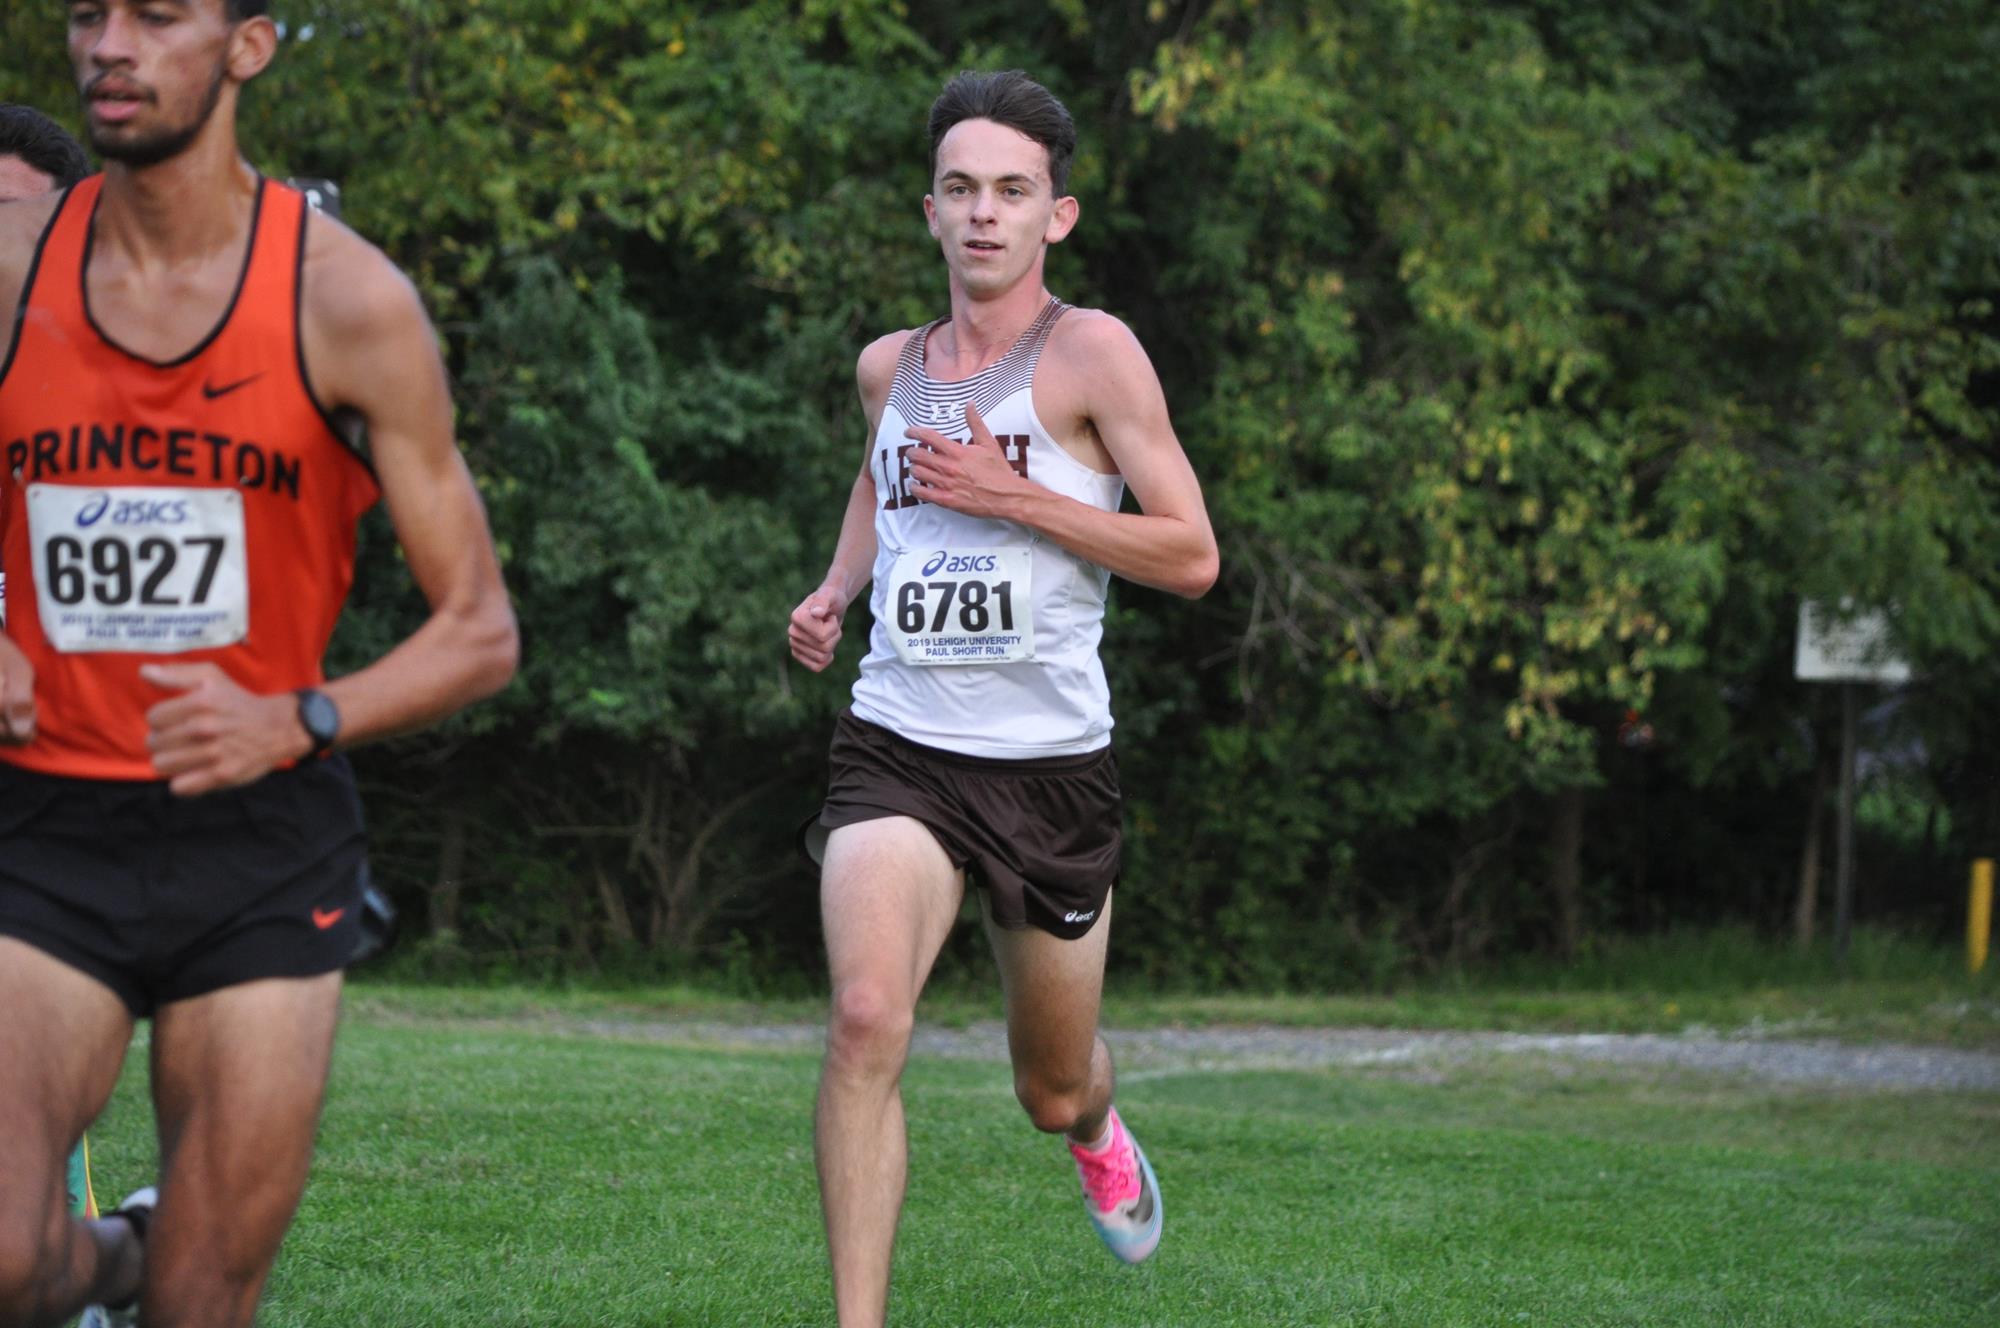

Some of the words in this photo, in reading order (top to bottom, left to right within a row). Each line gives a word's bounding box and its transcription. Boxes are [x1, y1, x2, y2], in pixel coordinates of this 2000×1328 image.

[8, 423, 301, 501] PRINCETON
[46, 536, 226, 606] 6927
[946, 555, 996, 573] asics
[897, 580, 1014, 634] 6781
[907, 638, 930, 647] 2019
[933, 637, 966, 646] LEHIGH
[969, 635, 1022, 646] UNIVERSITY
[925, 648, 950, 656] PAUL
[952, 647, 983, 655] SHORT
[985, 646, 1005, 655] RUN
